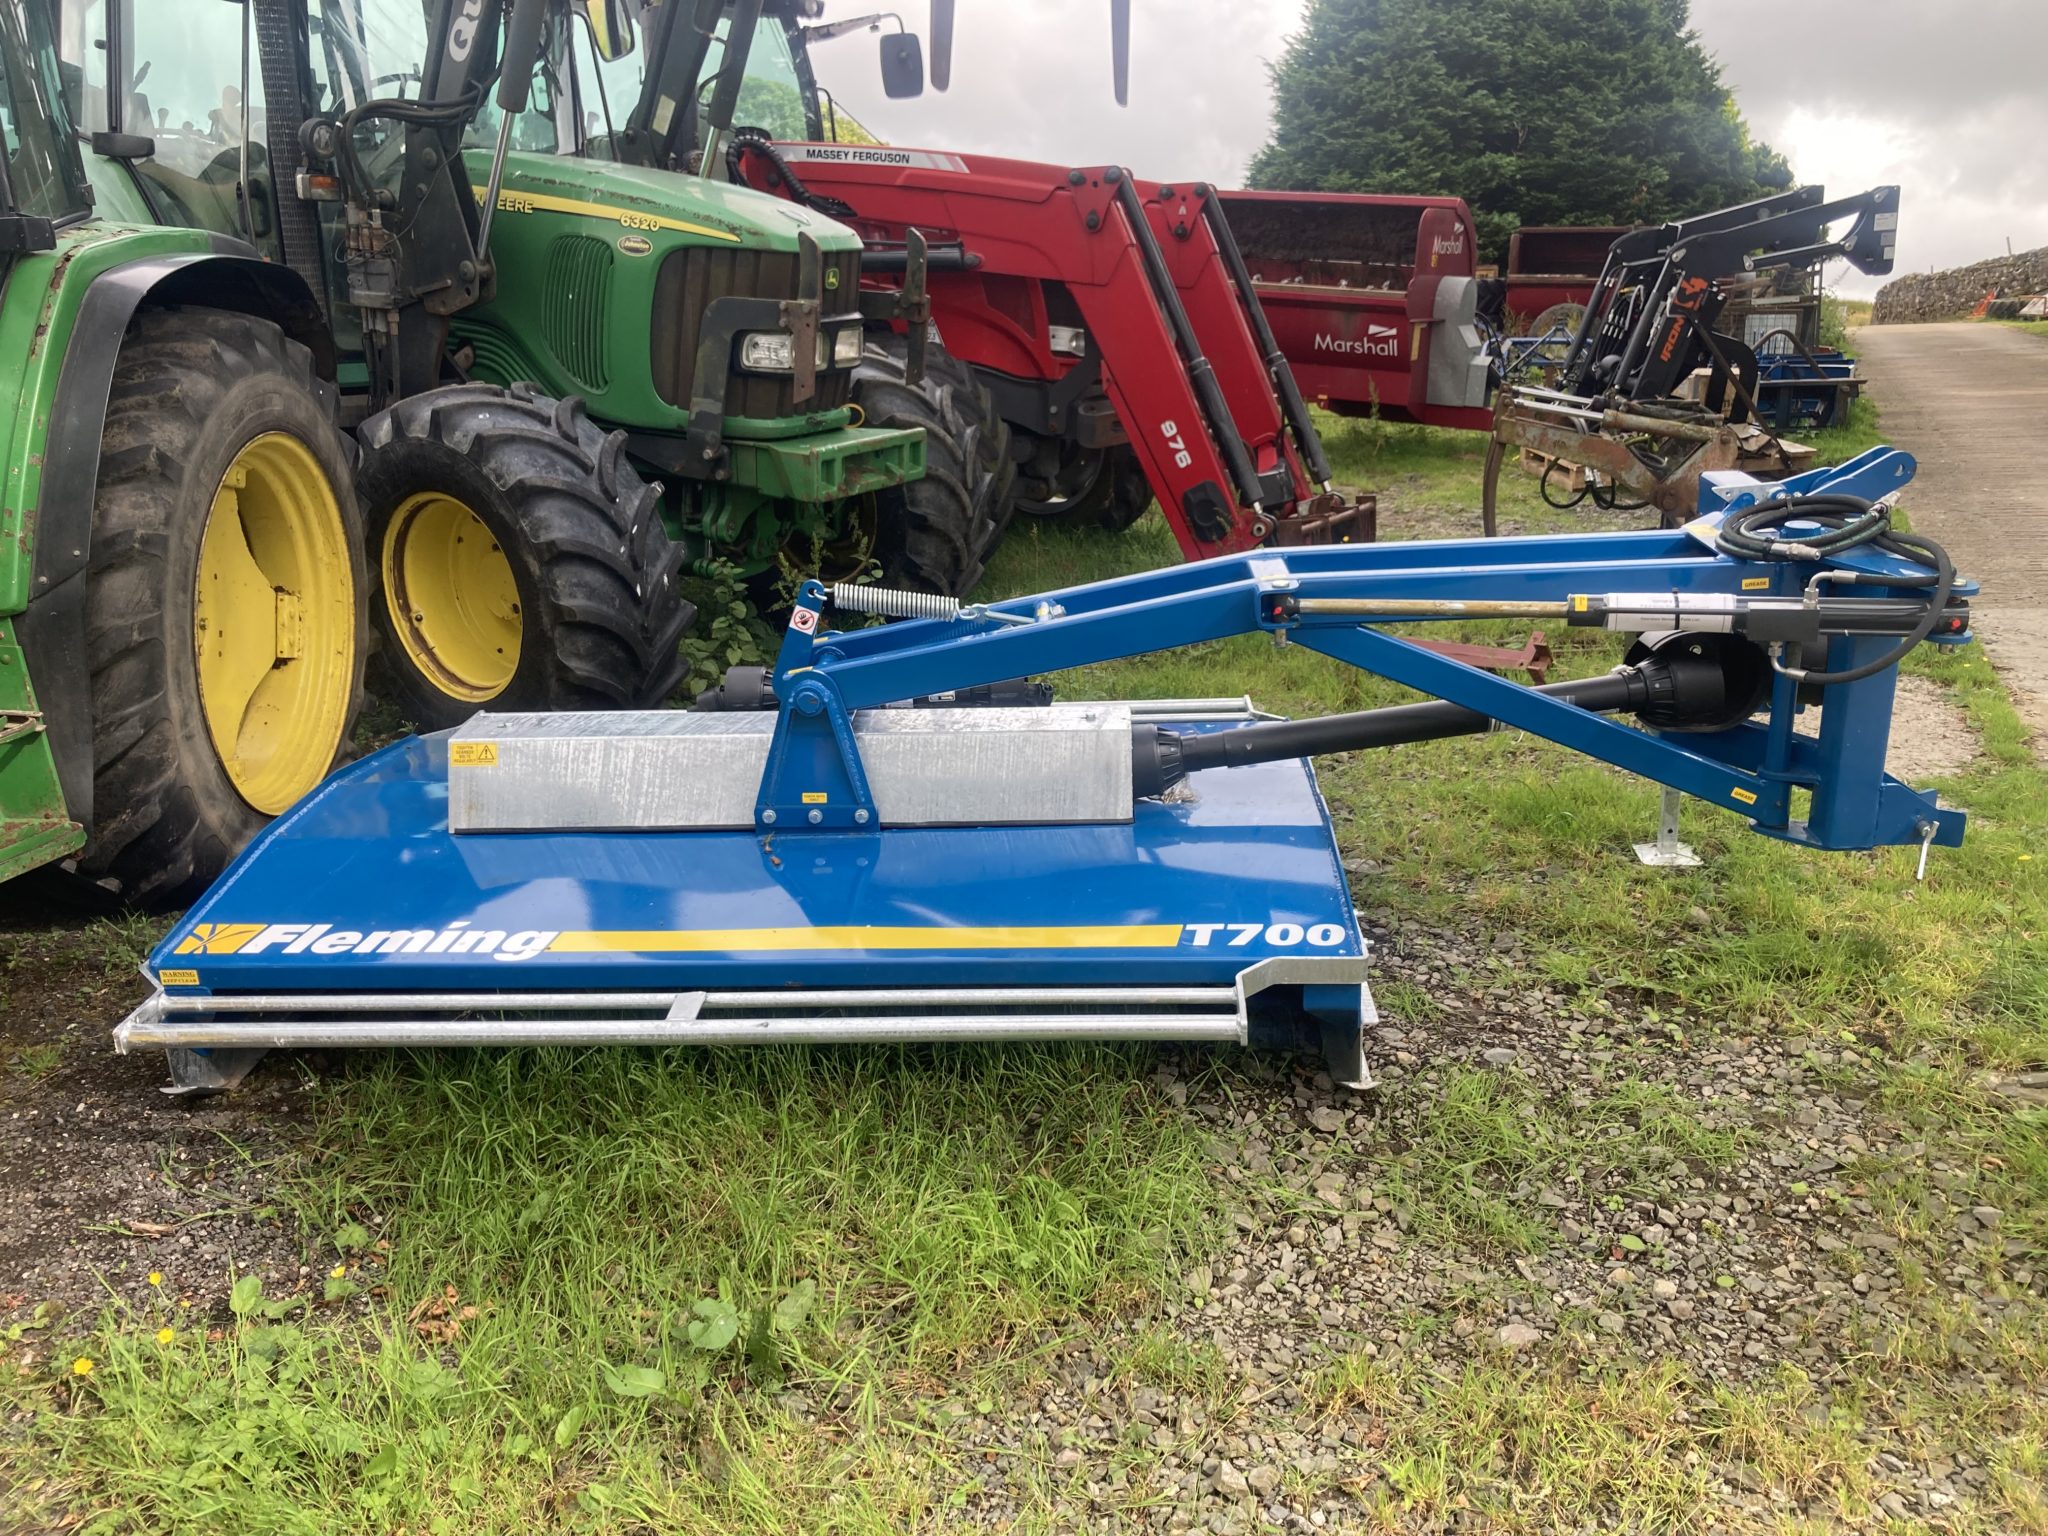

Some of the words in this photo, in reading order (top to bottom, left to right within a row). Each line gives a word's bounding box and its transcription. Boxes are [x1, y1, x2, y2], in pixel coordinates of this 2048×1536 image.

[806, 148, 850, 161] MASSEY
[852, 151, 911, 164] FERGUSON
[497, 198, 534, 214] EERE
[620, 213, 660, 232] 6320
[1432, 234, 1463, 255] Marshall
[1314, 332, 1399, 357] Marshall
[1660, 315, 1687, 362] IRON
[1160, 419, 1192, 469] 976
[1744, 580, 1768, 588] GREASE
[237, 921, 560, 961] Fleming
[1185, 923, 1346, 947] T700
